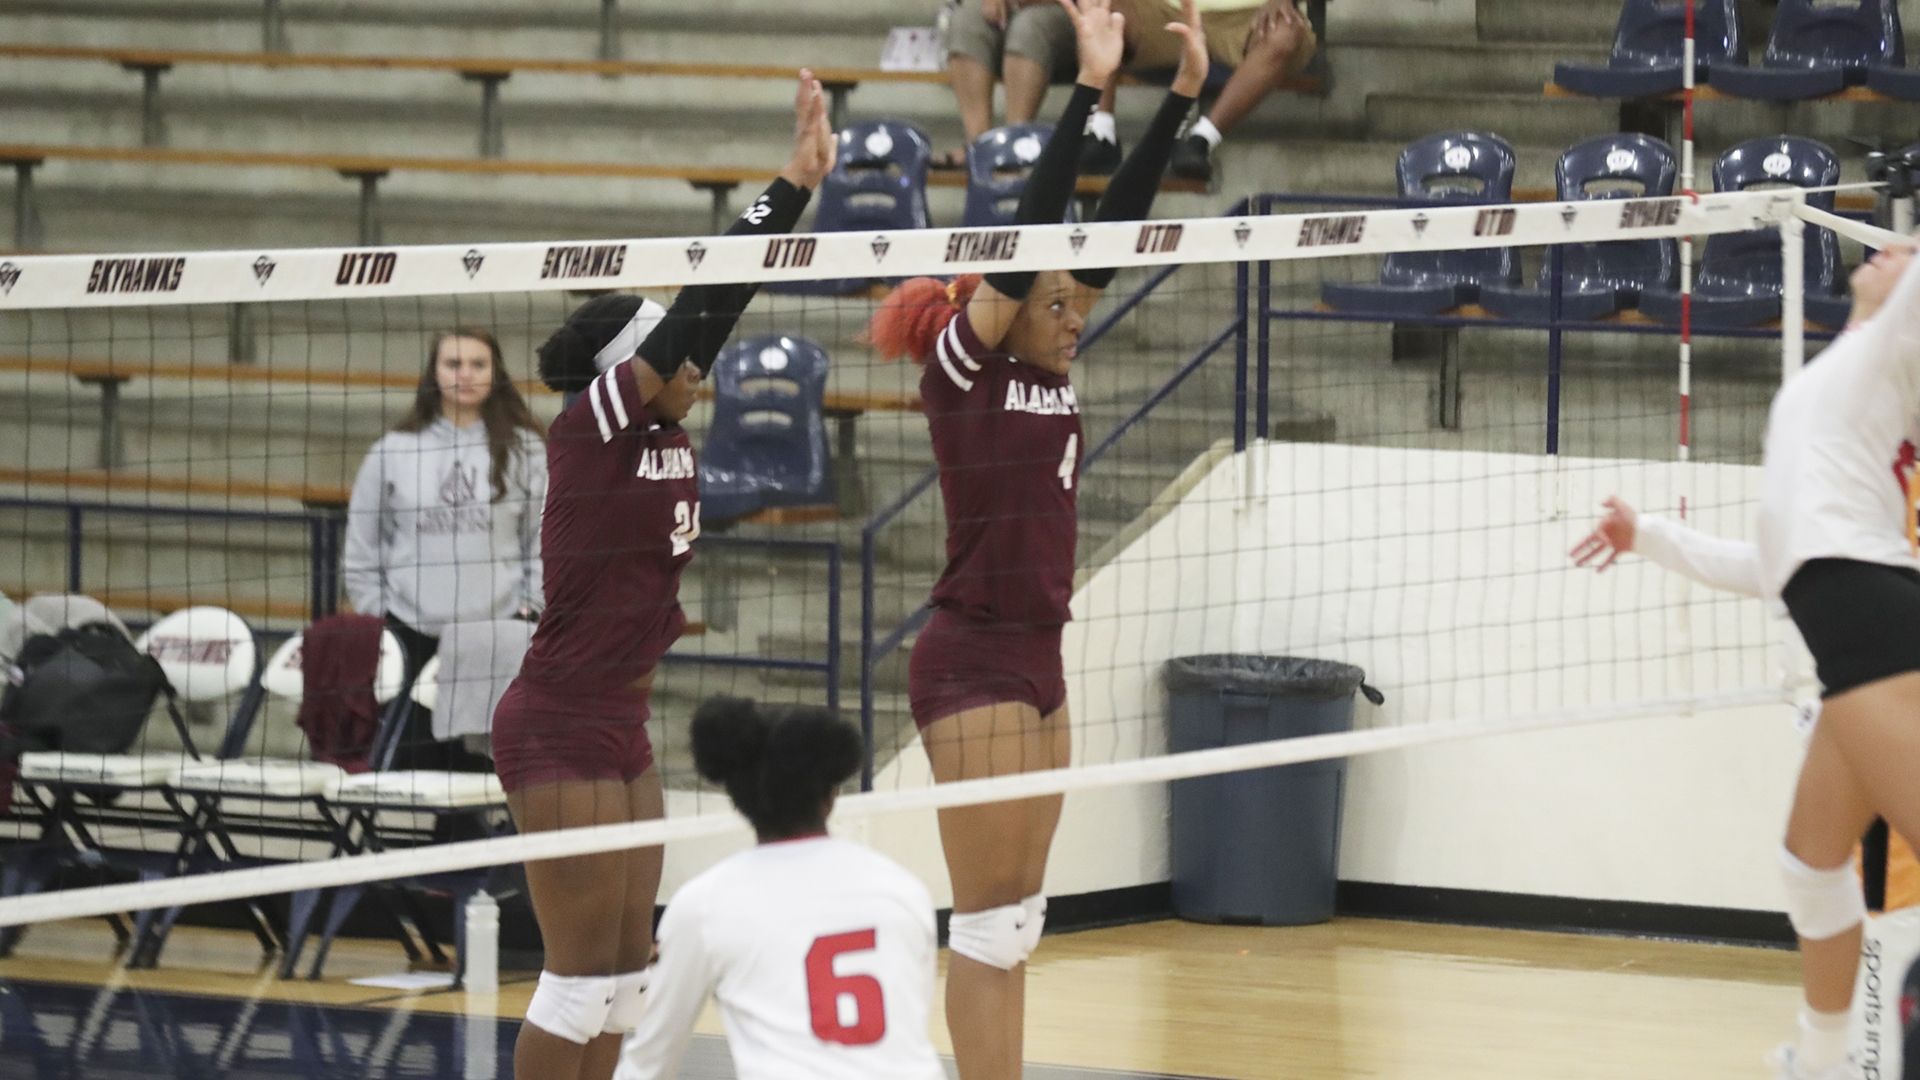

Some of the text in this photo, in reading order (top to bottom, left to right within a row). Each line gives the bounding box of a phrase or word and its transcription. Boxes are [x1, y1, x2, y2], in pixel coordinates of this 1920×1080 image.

[86, 257, 187, 294] SKYHAWKS
[335, 252, 398, 286] UTM
[540, 244, 628, 280] SKYHAWKS
[763, 237, 818, 269] UTM
[944, 230, 1021, 263] SKYHAWKS
[1135, 223, 1184, 254] UTM
[1472, 208, 1517, 238] UTM
[805, 927, 886, 1046] 6
[1861, 938, 1884, 1025] sports
